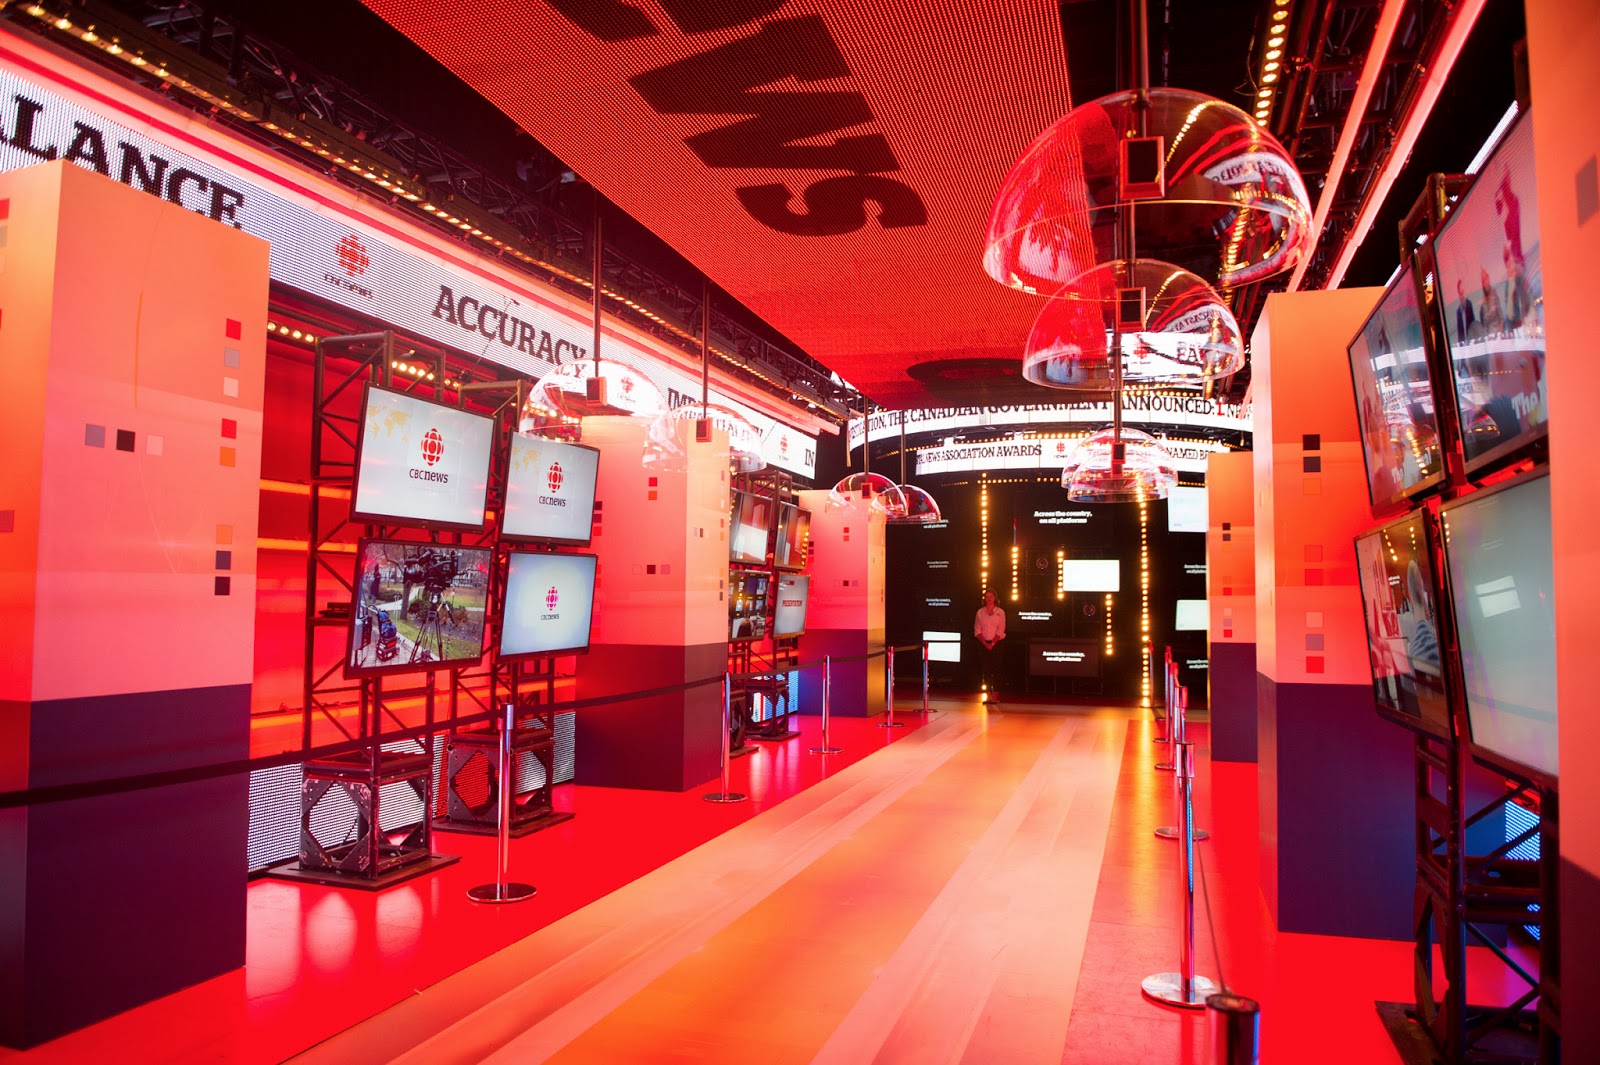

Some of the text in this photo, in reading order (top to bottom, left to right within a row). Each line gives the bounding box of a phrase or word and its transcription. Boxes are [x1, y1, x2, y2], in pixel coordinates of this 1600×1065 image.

[0, 94, 244, 230] LANCE
[431, 284, 587, 370] ACCURACY
[942, 446, 995, 460] ASSOCIATION
[996, 444, 1042, 457] AWARDS
[1056, 517, 1088, 525] platforms
